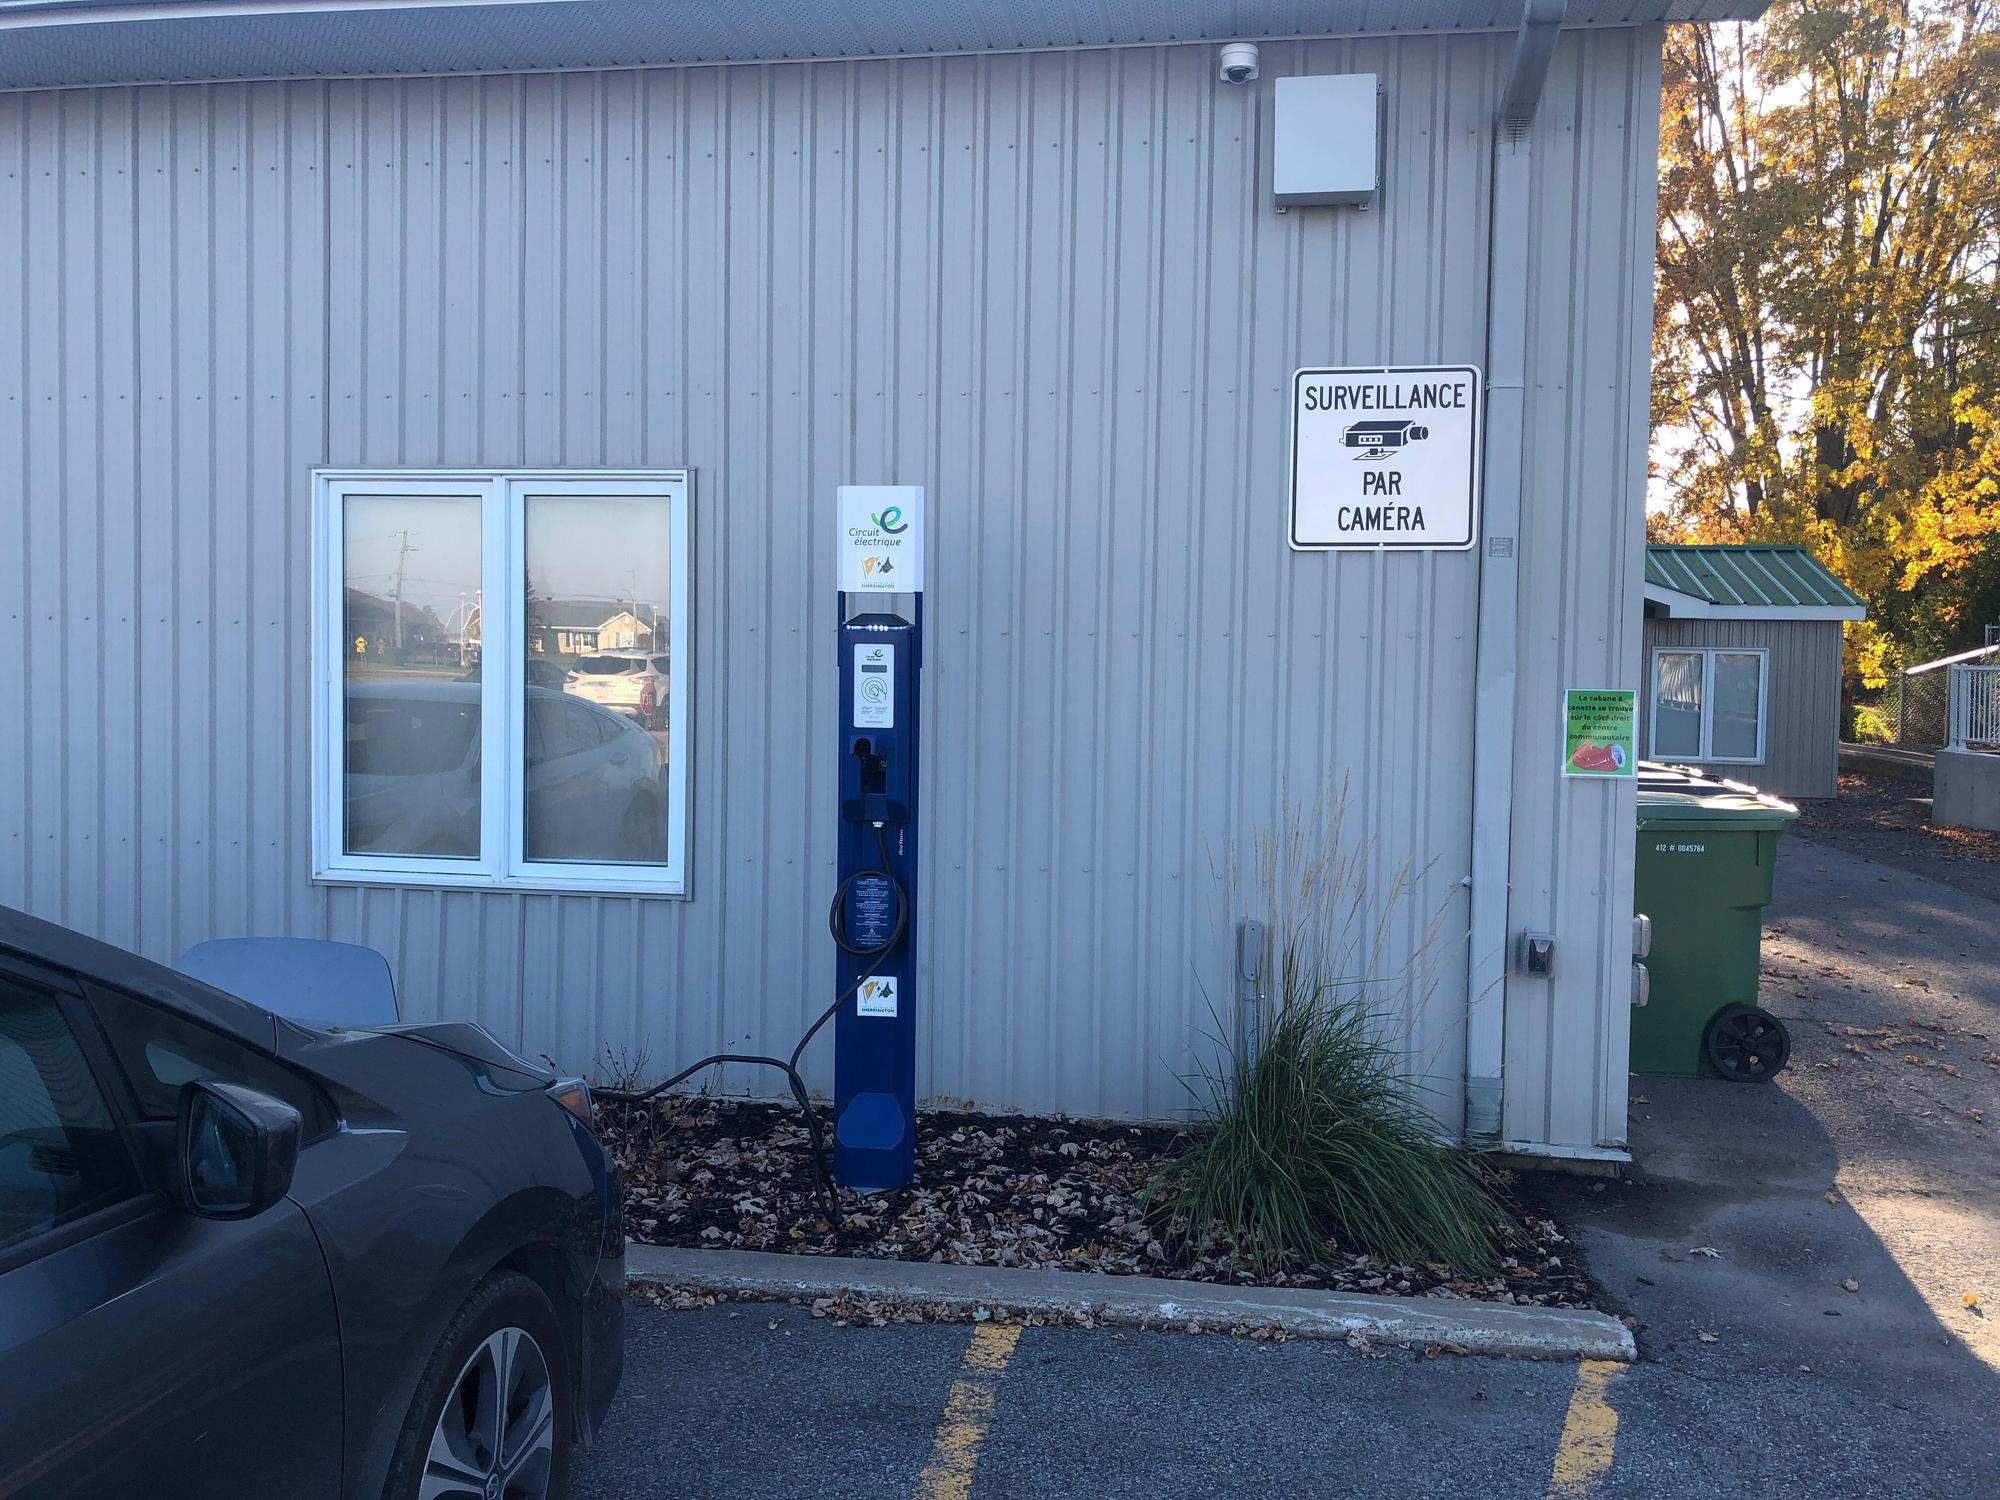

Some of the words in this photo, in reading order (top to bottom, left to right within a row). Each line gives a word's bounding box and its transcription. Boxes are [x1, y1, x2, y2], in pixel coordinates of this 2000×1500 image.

[1304, 383, 1466, 411] SURVEILLANCE
[1363, 471, 1402, 496] PAR
[1337, 501, 1426, 532] CAMÉRA
[848, 527, 880, 537] Circuit
[854, 537, 901, 548] électrique
[1610, 714, 1631, 722] droit
[1655, 844, 1667, 852] 412
